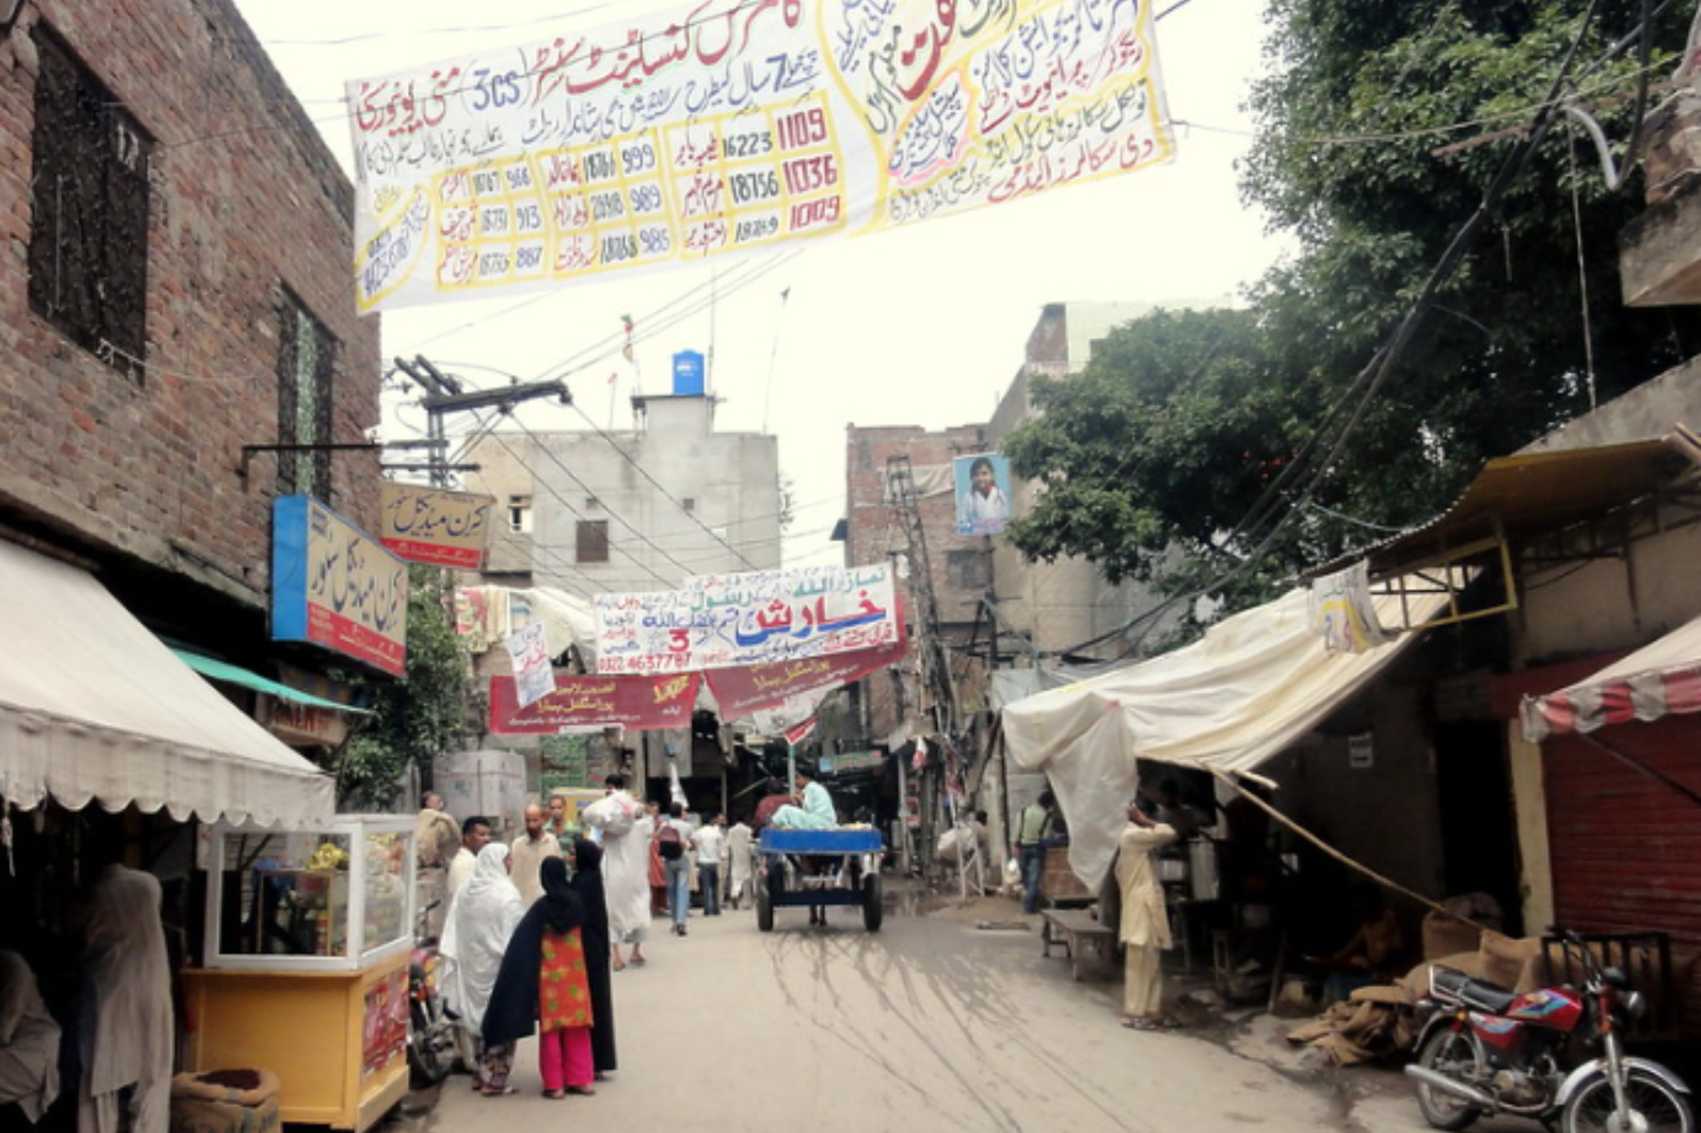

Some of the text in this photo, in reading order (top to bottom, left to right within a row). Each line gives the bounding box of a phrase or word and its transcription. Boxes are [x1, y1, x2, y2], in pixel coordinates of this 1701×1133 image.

[722, 131, 774, 159] 16223
[776, 108, 828, 151] 1109
[782, 153, 839, 195] 1036
[667, 628, 691, 653] 3
[735, 589, 887, 648] خارش
